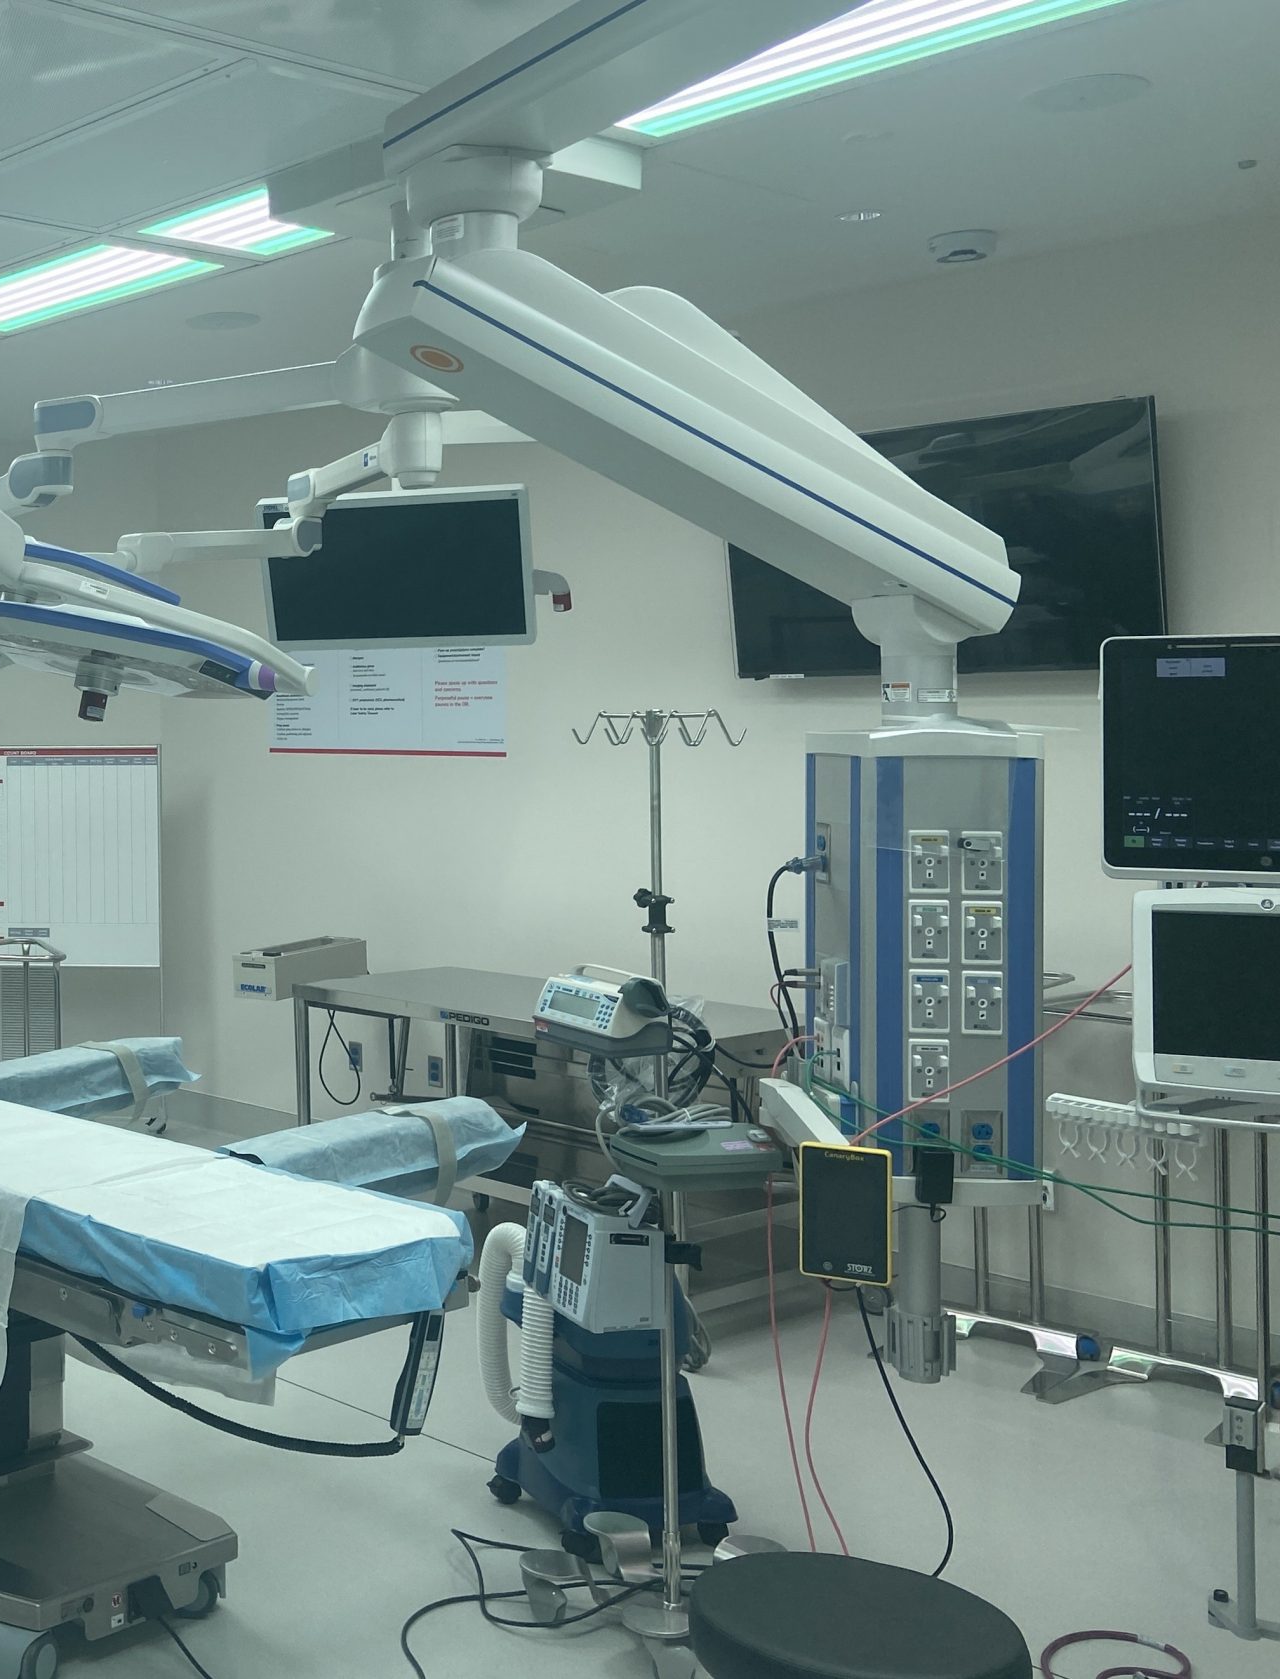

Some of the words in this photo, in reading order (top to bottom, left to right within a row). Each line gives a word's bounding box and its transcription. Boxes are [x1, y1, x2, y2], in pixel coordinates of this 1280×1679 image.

[240, 983, 267, 993] ECOLAB
[448, 1011, 490, 1026] PEDIGO
[846, 1263, 873, 1274] STORZ
